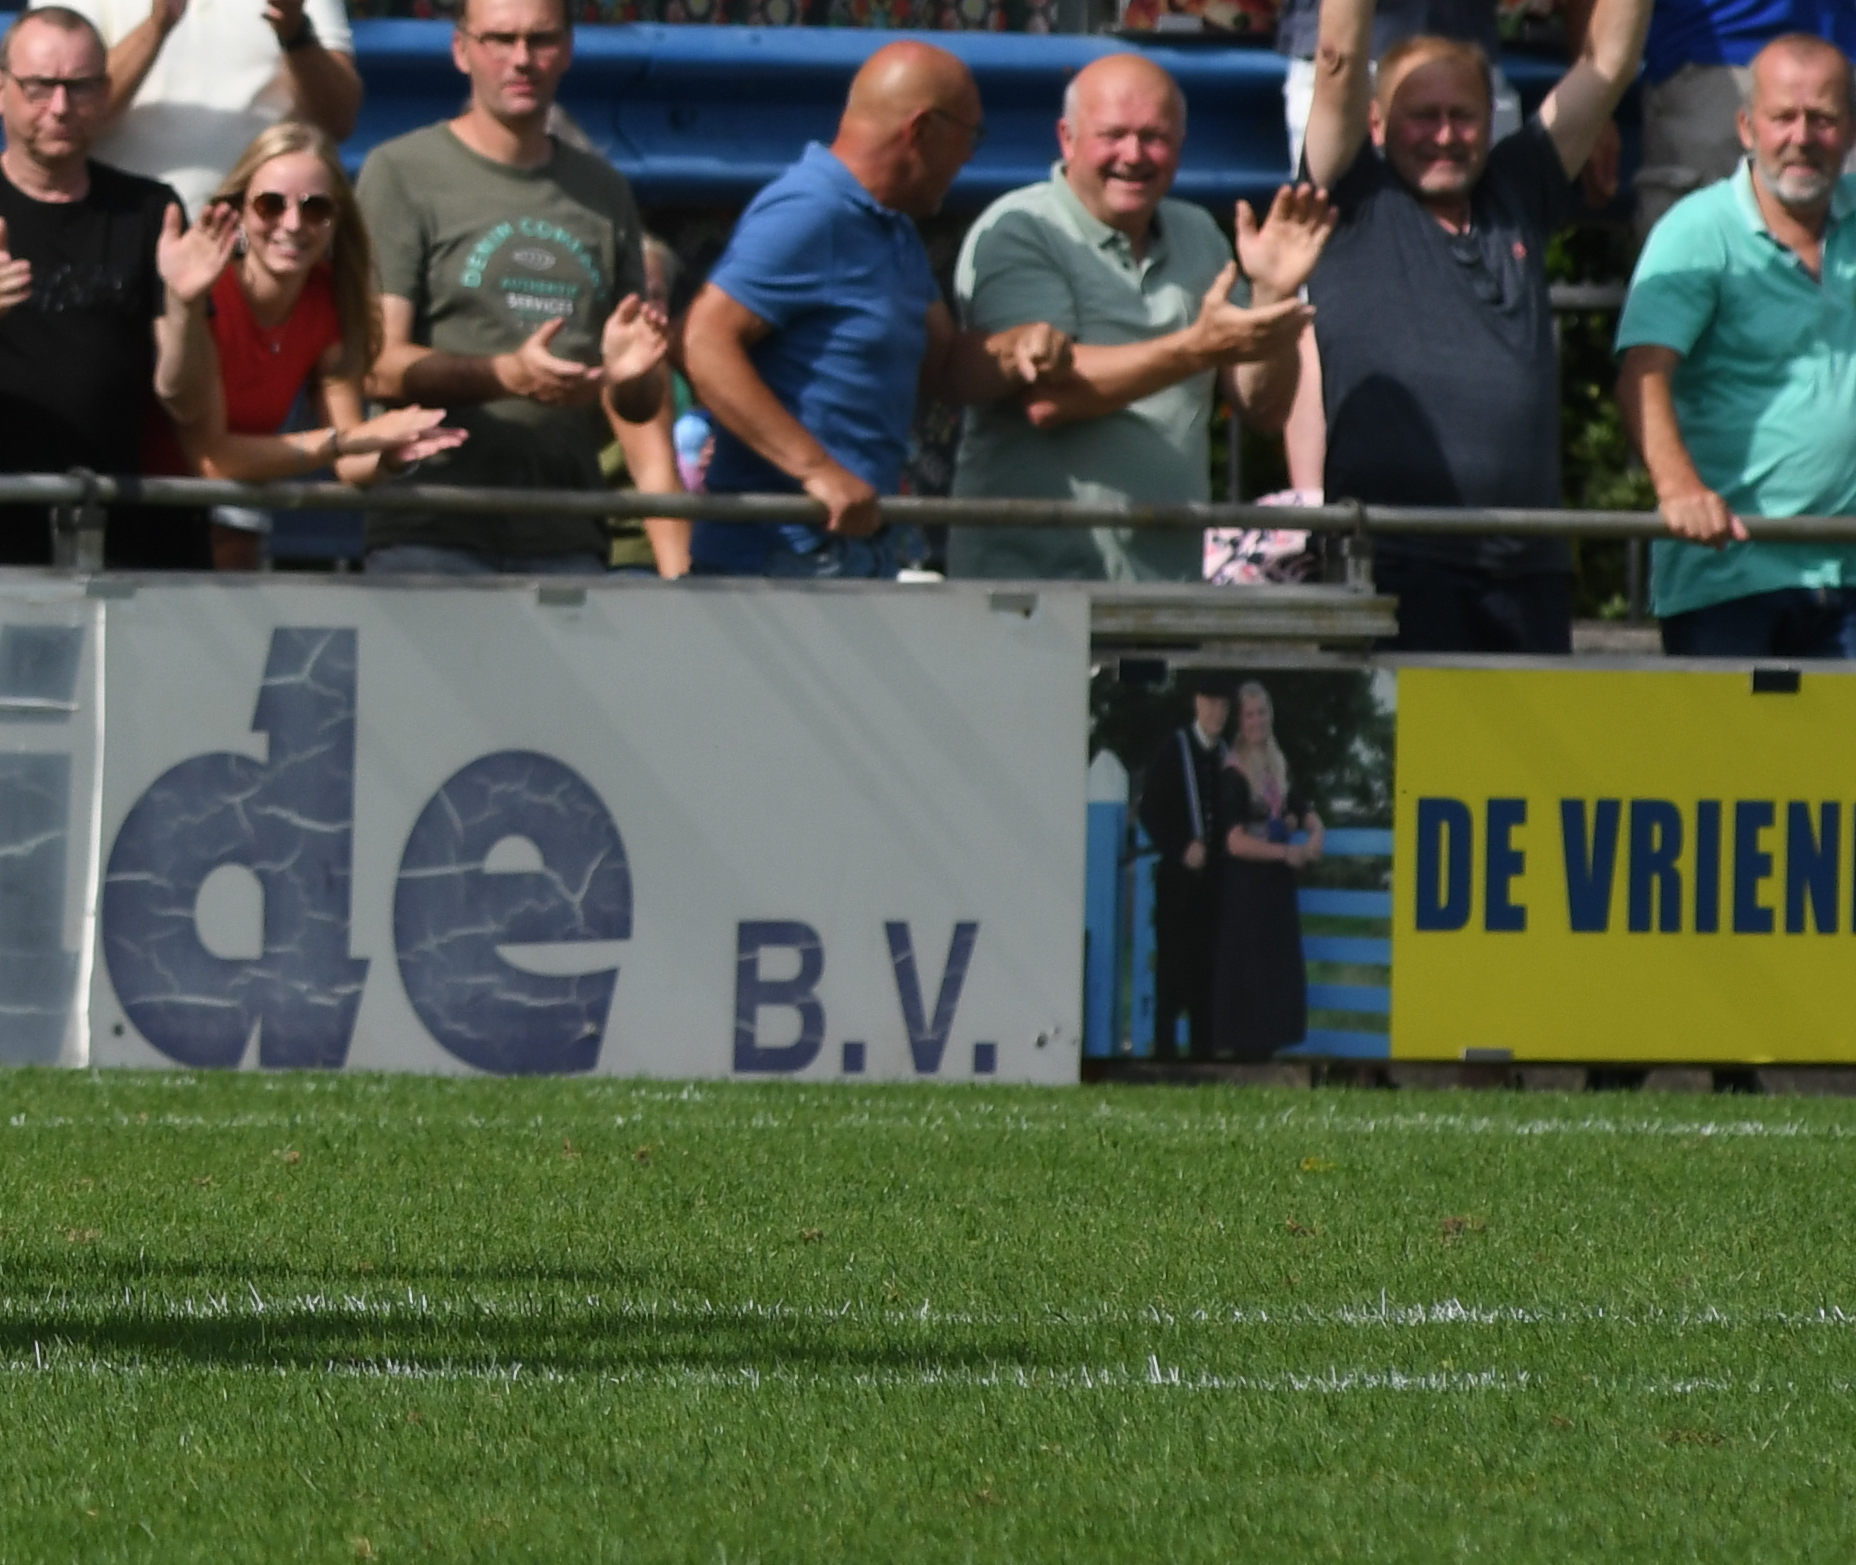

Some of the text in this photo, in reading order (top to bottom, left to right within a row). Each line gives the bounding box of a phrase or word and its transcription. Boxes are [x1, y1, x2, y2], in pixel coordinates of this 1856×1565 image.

[1415, 797, 1856, 935] DE VRIEN
[731, 918, 999, 1075] B.V.
